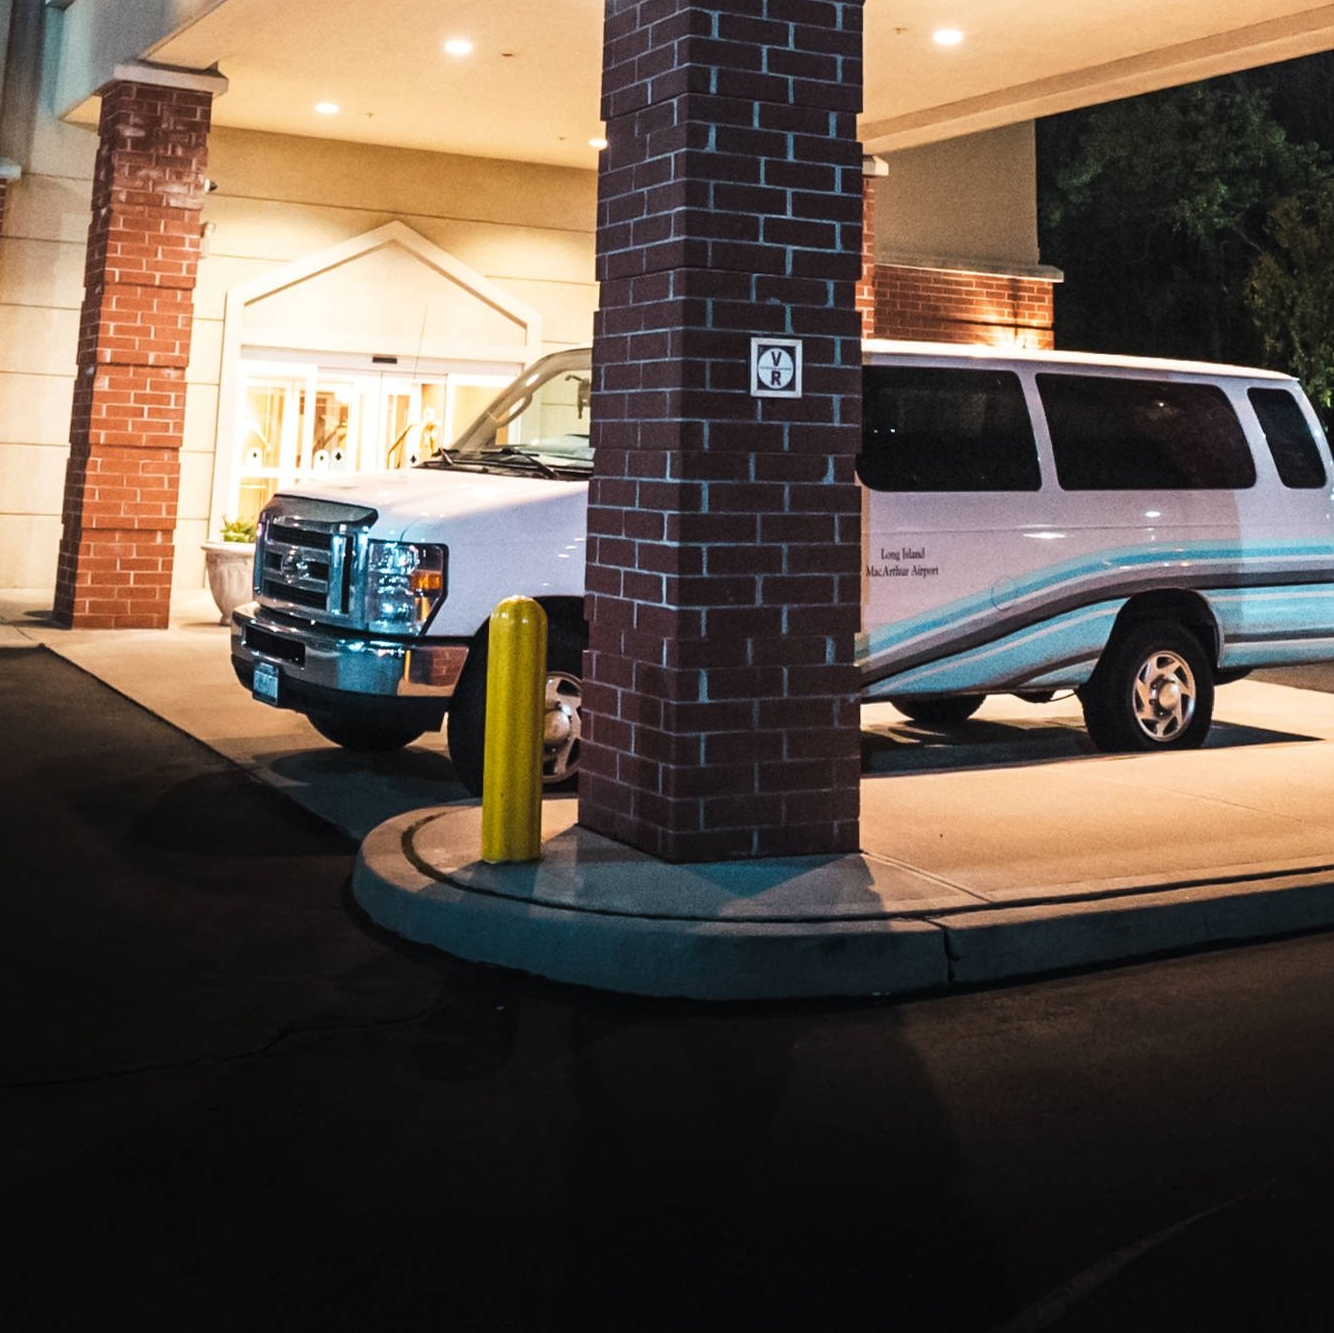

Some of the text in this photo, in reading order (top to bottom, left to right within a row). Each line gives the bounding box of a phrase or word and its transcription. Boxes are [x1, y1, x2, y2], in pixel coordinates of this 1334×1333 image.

[771, 351, 782, 366] V
[771, 370, 781, 386] R
[881, 547, 925, 561] Long Island
[911, 565, 938, 578] Airport
